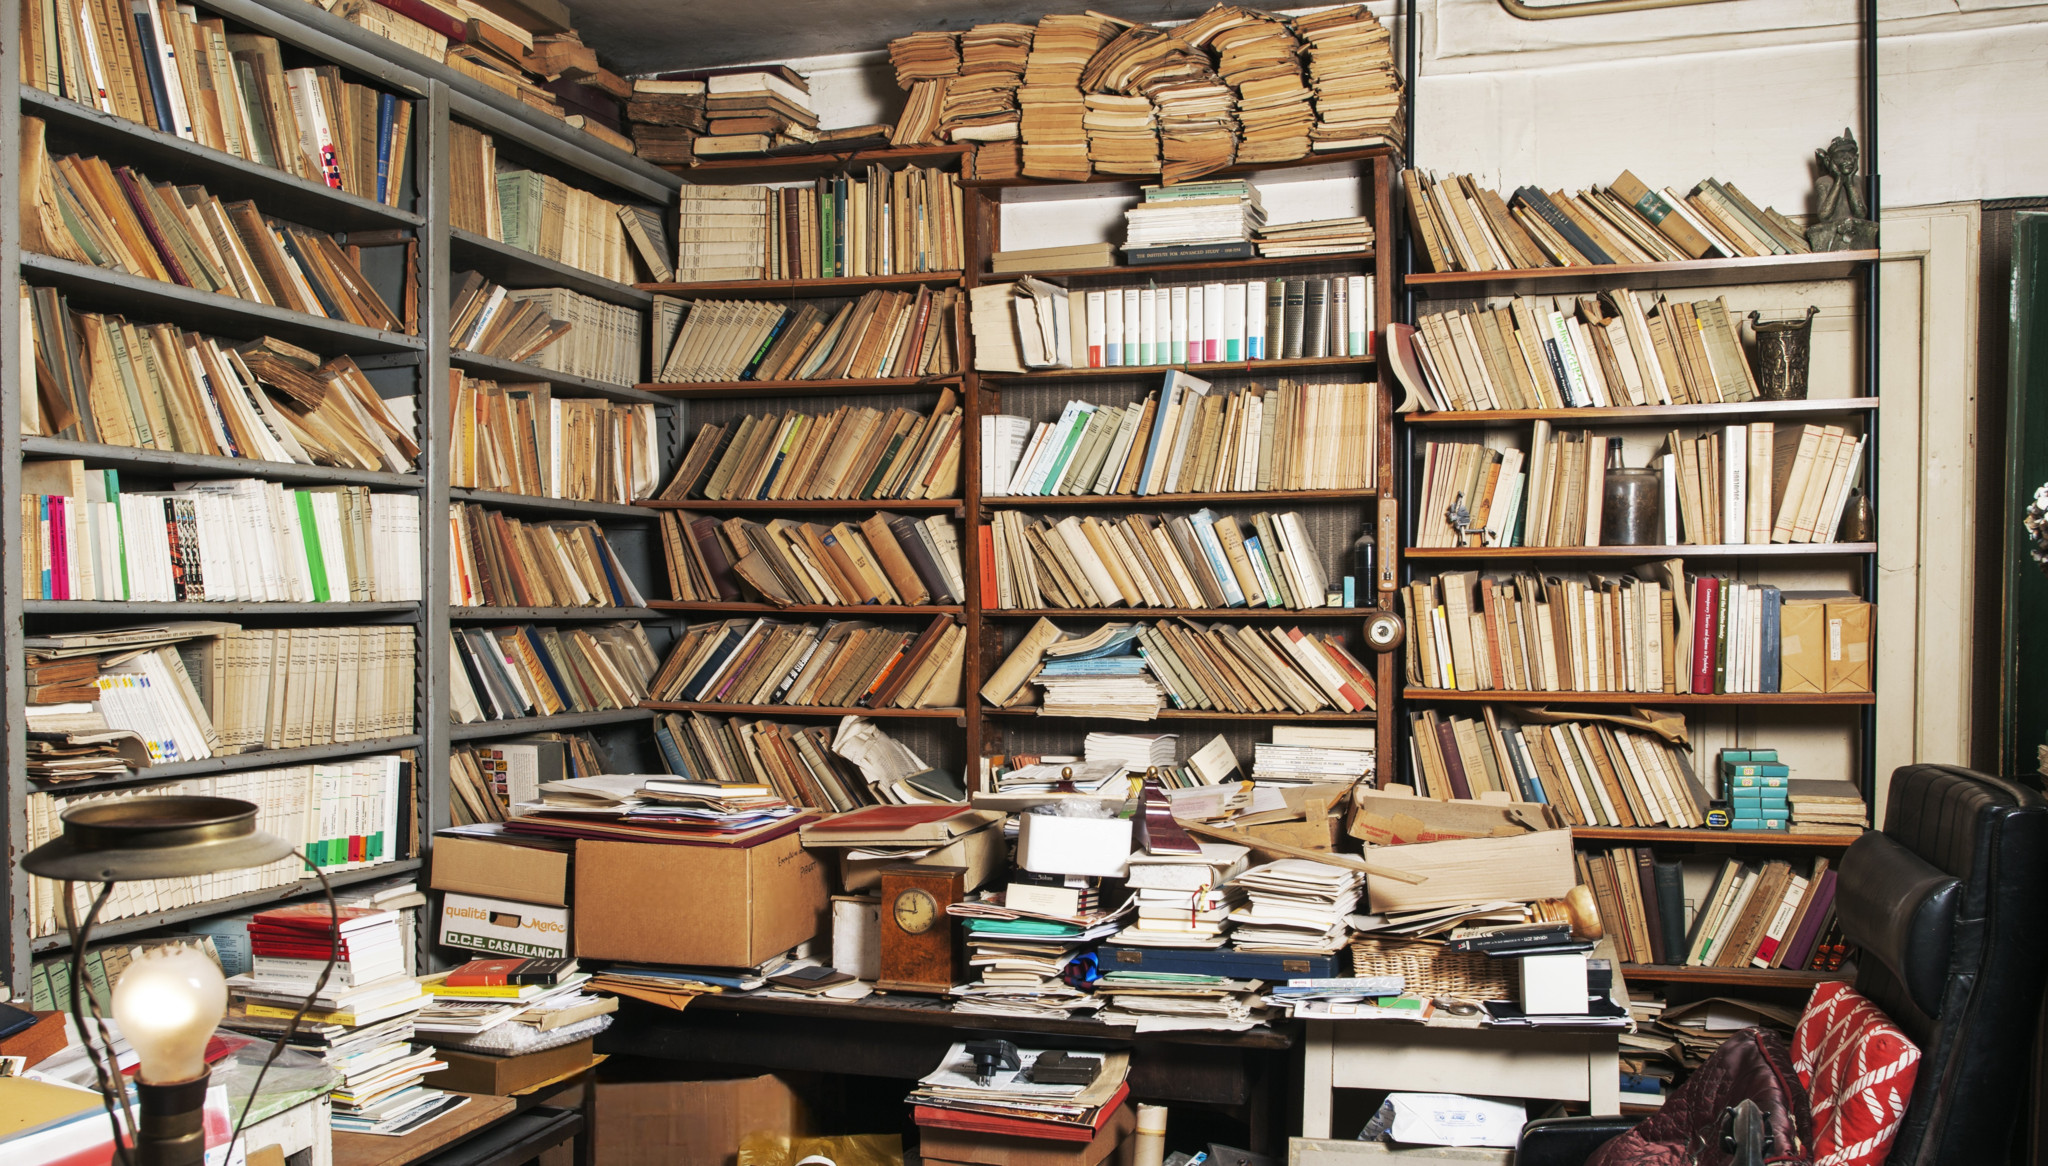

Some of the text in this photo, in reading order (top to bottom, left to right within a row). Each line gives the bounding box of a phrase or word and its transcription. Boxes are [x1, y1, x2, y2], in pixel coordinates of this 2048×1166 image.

[1554, 317, 1563, 329] the
[1559, 330, 1570, 347] lives
[1565, 349, 1573, 358] of
[1549, 342, 1557, 362] Readings
[1562, 379, 1571, 402] Psychology
[789, 669, 799, 677] OF
[446, 906, 566, 933] qualité Maroc
[447, 932, 561, 959] O.C.E. CASABLANCA
